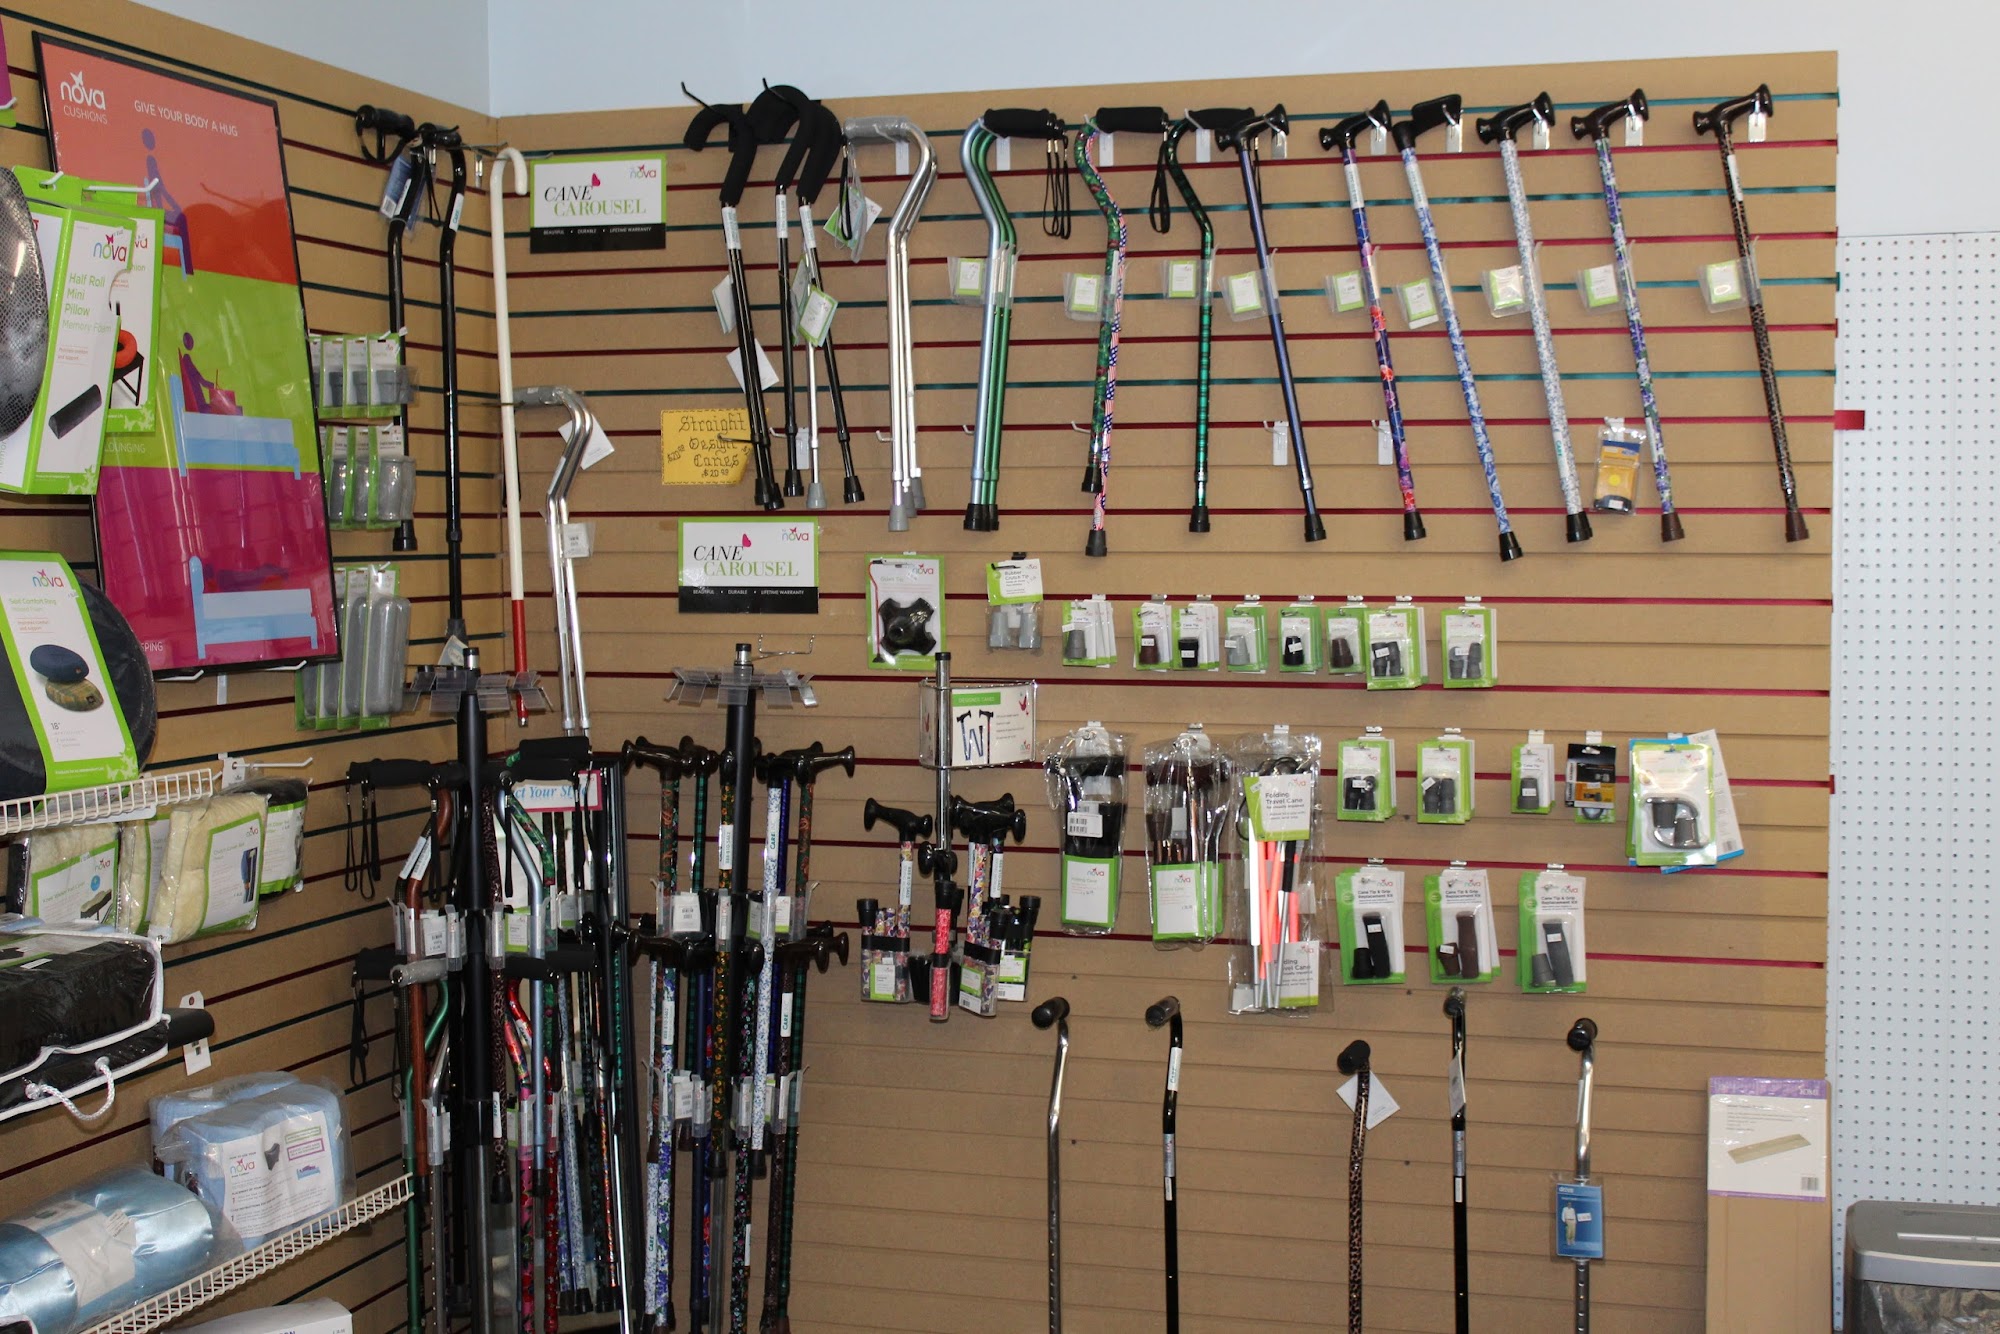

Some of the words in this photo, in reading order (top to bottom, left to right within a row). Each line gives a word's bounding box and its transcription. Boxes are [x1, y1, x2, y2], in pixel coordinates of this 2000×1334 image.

[60, 81, 107, 110] nova
[63, 105, 108, 125] CUSHIONS
[134, 100, 156, 117] GIVE
[158, 107, 183, 123] YOUR
[185, 113, 209, 130] BODY
[211, 121, 219, 132] A
[219, 123, 238, 137] HUG
[630, 169, 657, 179] nova
[544, 185, 593, 202] CANE
[553, 198, 647, 217] CAROUSEL
[93, 242, 127, 263] nova
[69, 272, 87, 286] Half
[89, 274, 106, 288] Roll
[67, 287, 85, 301] Mini
[64, 302, 91, 317] Pillow
[62, 319, 93, 334] Memory
[93, 322, 112, 334] Foam
[679, 412, 747, 435] Straight
[693, 453, 740, 468] Canes
[782, 531, 809, 542] nova
[693, 545, 744, 562] CANE
[703, 559, 799, 577] CAROUSEL
[32, 575, 65, 588] nova
[529, 785, 557, 799] Your
[230, 1160, 256, 1174] nova
